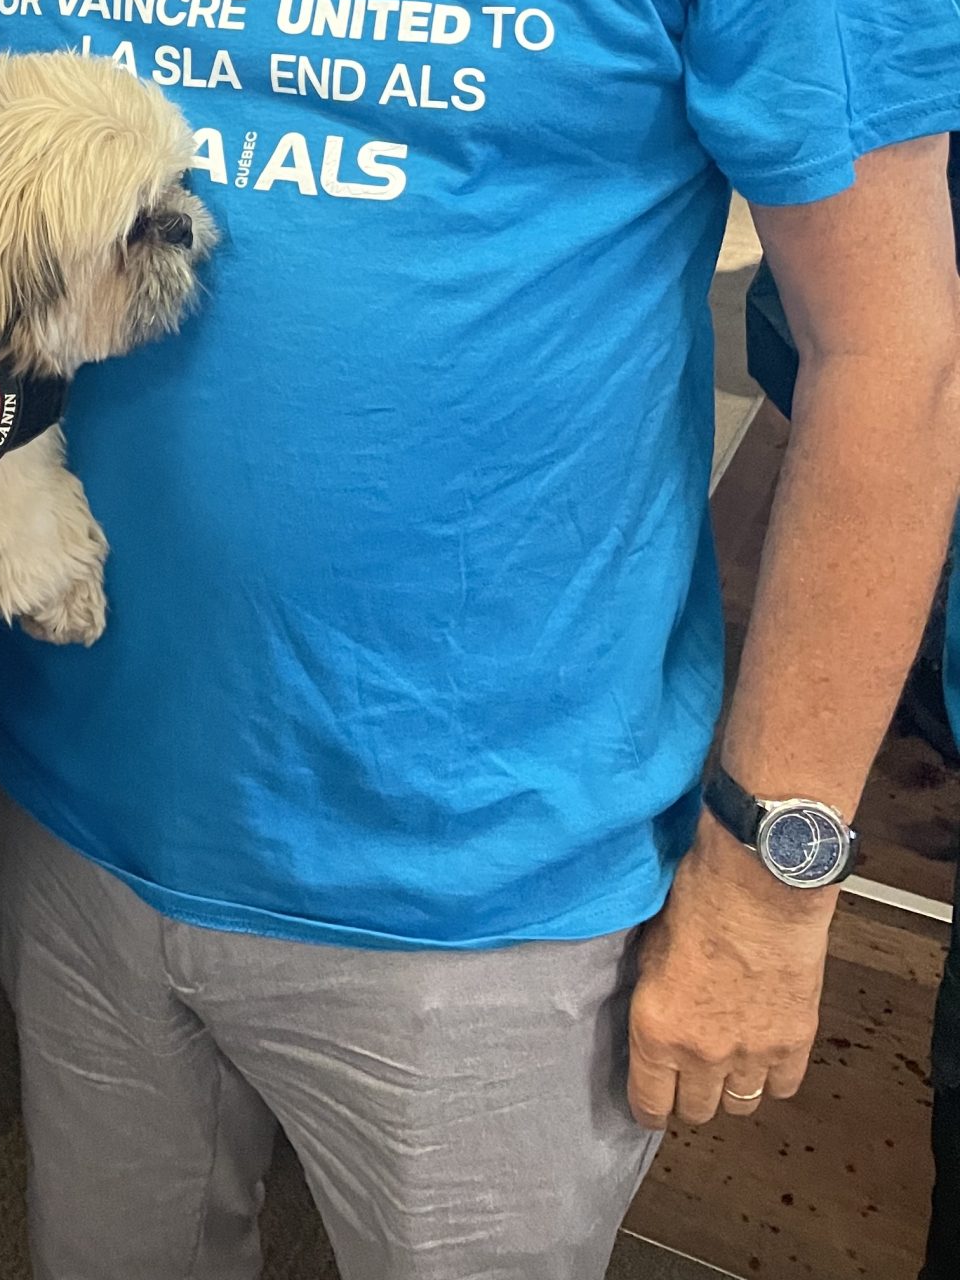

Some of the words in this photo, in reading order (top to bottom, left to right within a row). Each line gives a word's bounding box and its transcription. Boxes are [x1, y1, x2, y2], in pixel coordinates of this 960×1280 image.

[481, 6, 556, 52] TO
[152, 45, 243, 90] SLA
[270, 53, 367, 103] END
[378, 63, 487, 112] ALS
[234, 131, 258, 189] QUÉBEC
[254, 132, 408, 201] ALS
